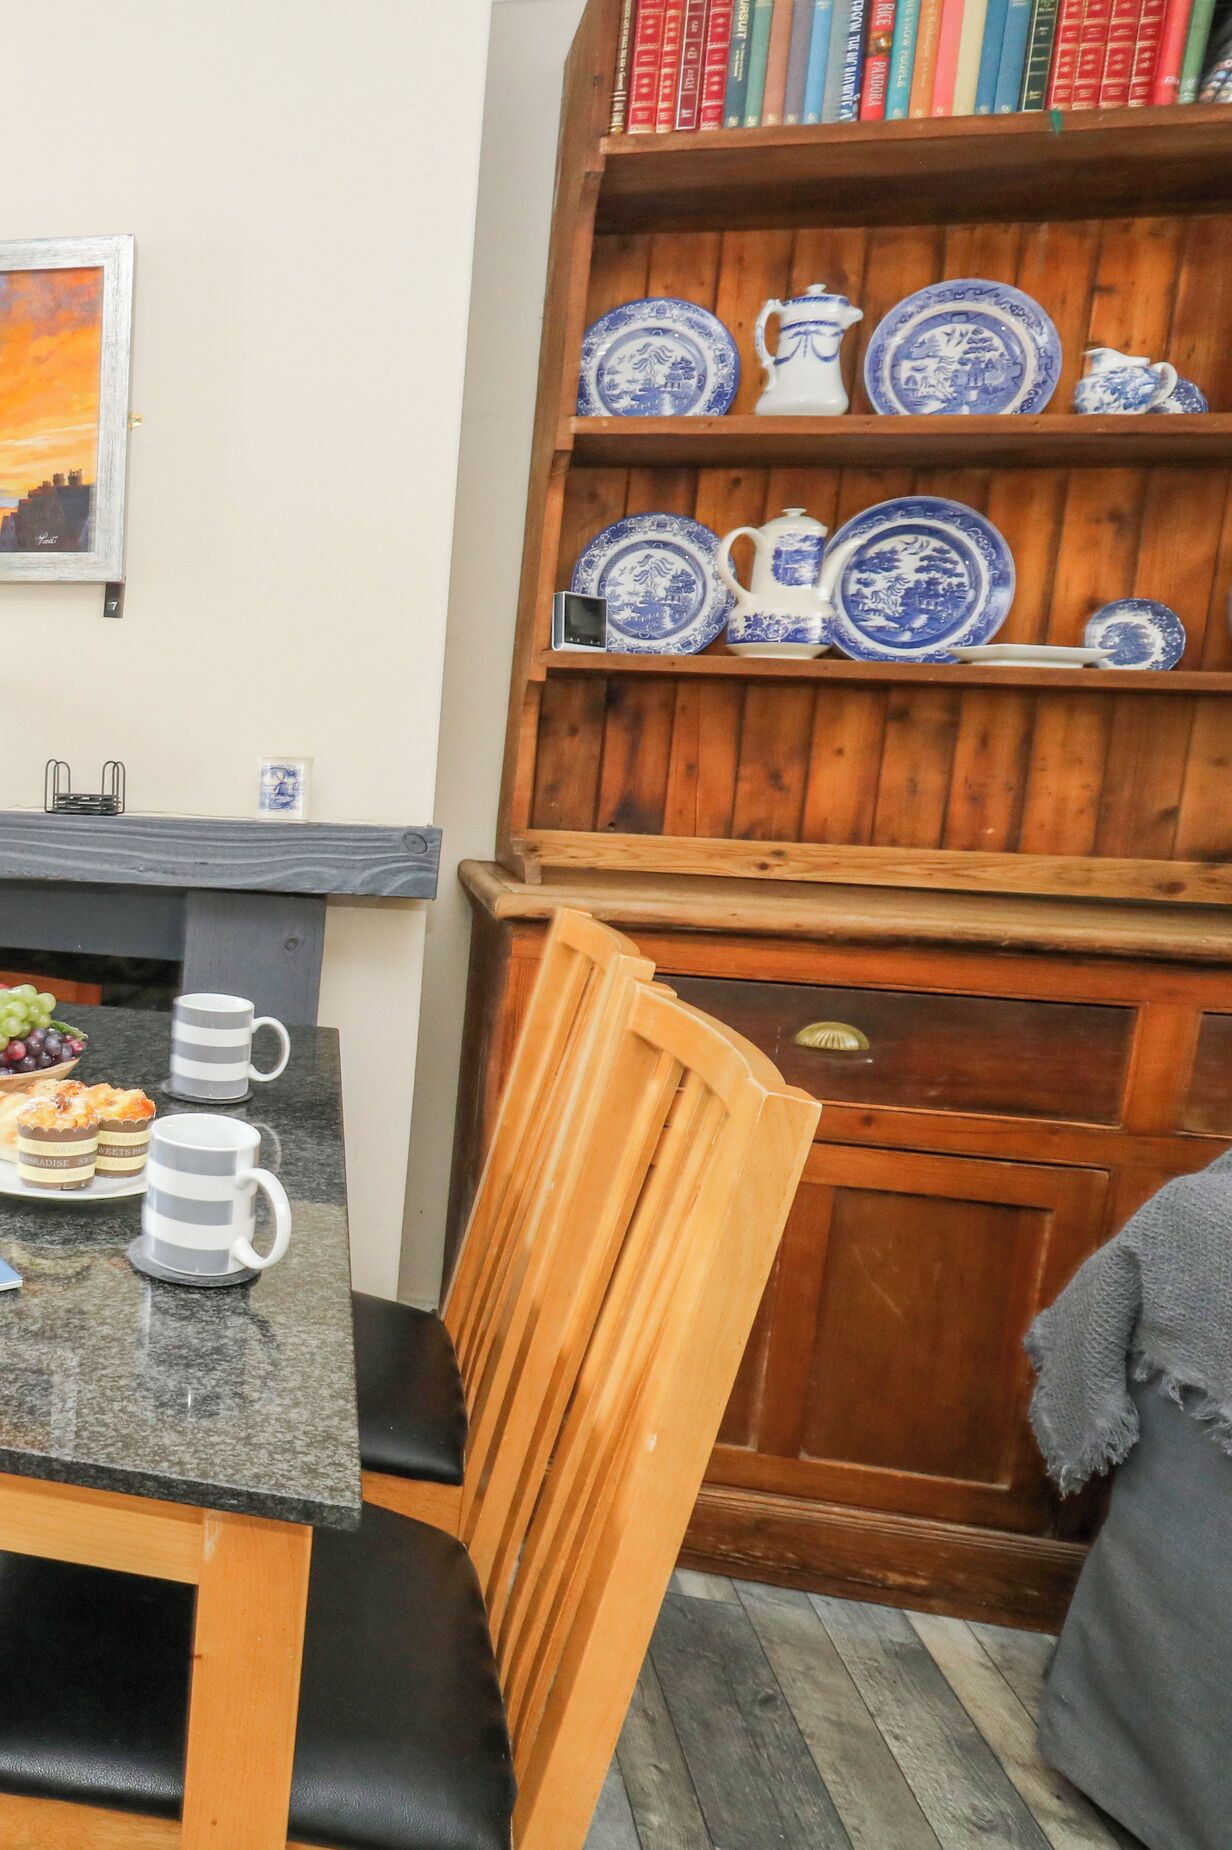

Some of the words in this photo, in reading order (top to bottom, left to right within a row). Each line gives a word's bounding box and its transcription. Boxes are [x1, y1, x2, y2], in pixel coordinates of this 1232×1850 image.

[737, 0, 750, 39] URSUIT
[849, 0, 864, 32] ERSON
[868, 61, 886, 106] PANDORA
[97, 1147, 132, 1157] WEETS
